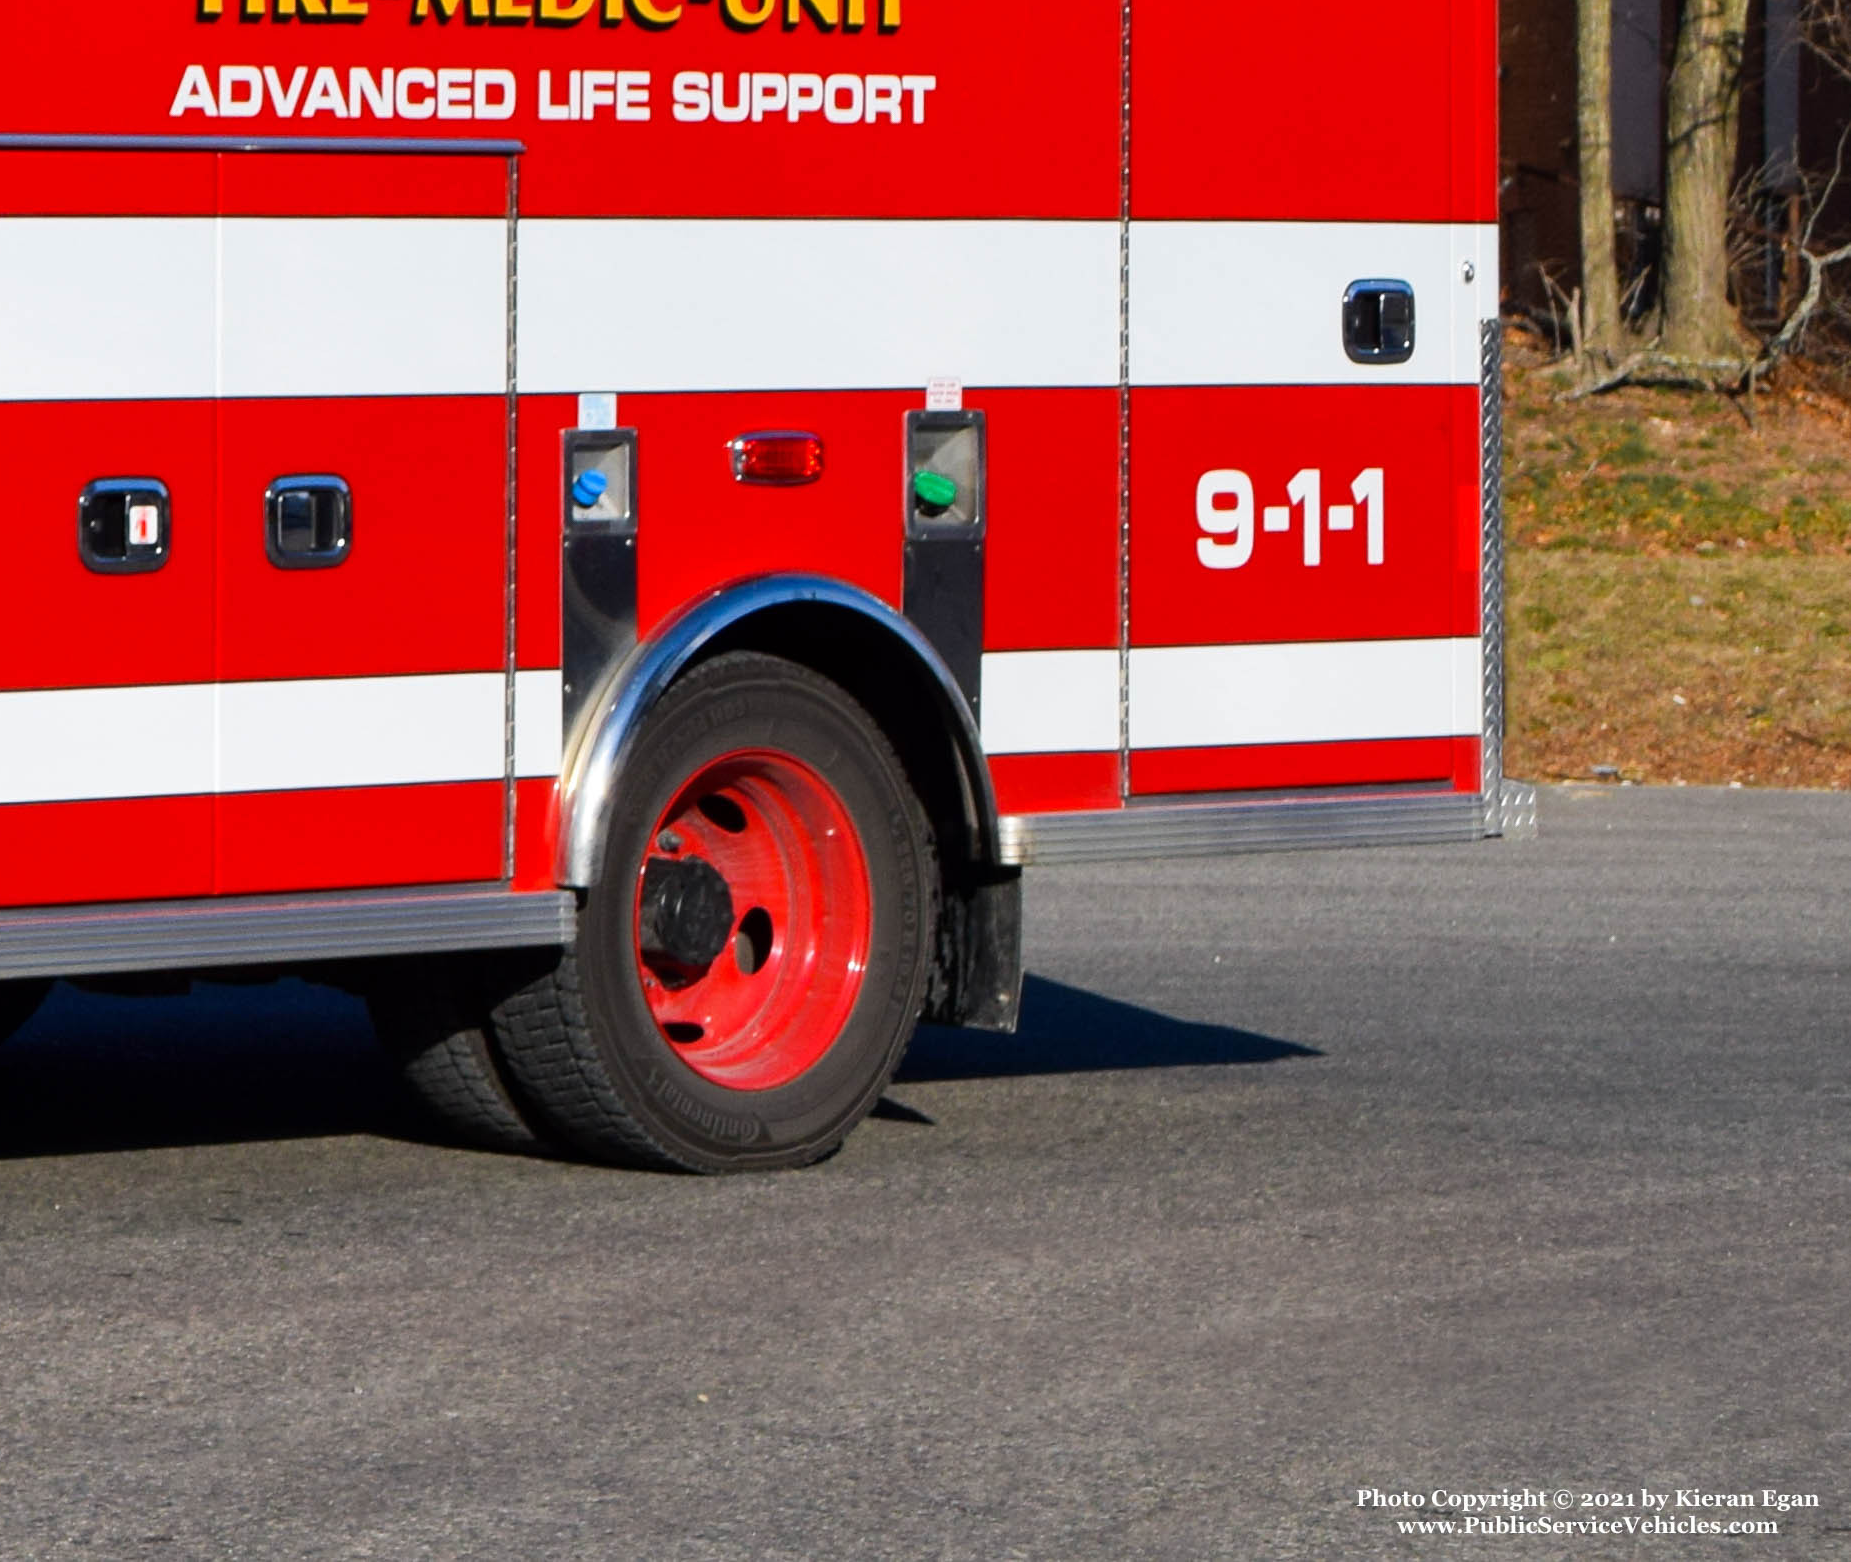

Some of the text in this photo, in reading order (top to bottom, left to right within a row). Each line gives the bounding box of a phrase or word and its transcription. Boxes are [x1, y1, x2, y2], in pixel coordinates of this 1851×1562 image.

[169, 65, 936, 124] ADVANCED LIFE SUPPORT
[1196, 468, 1384, 569] 9-1-1
